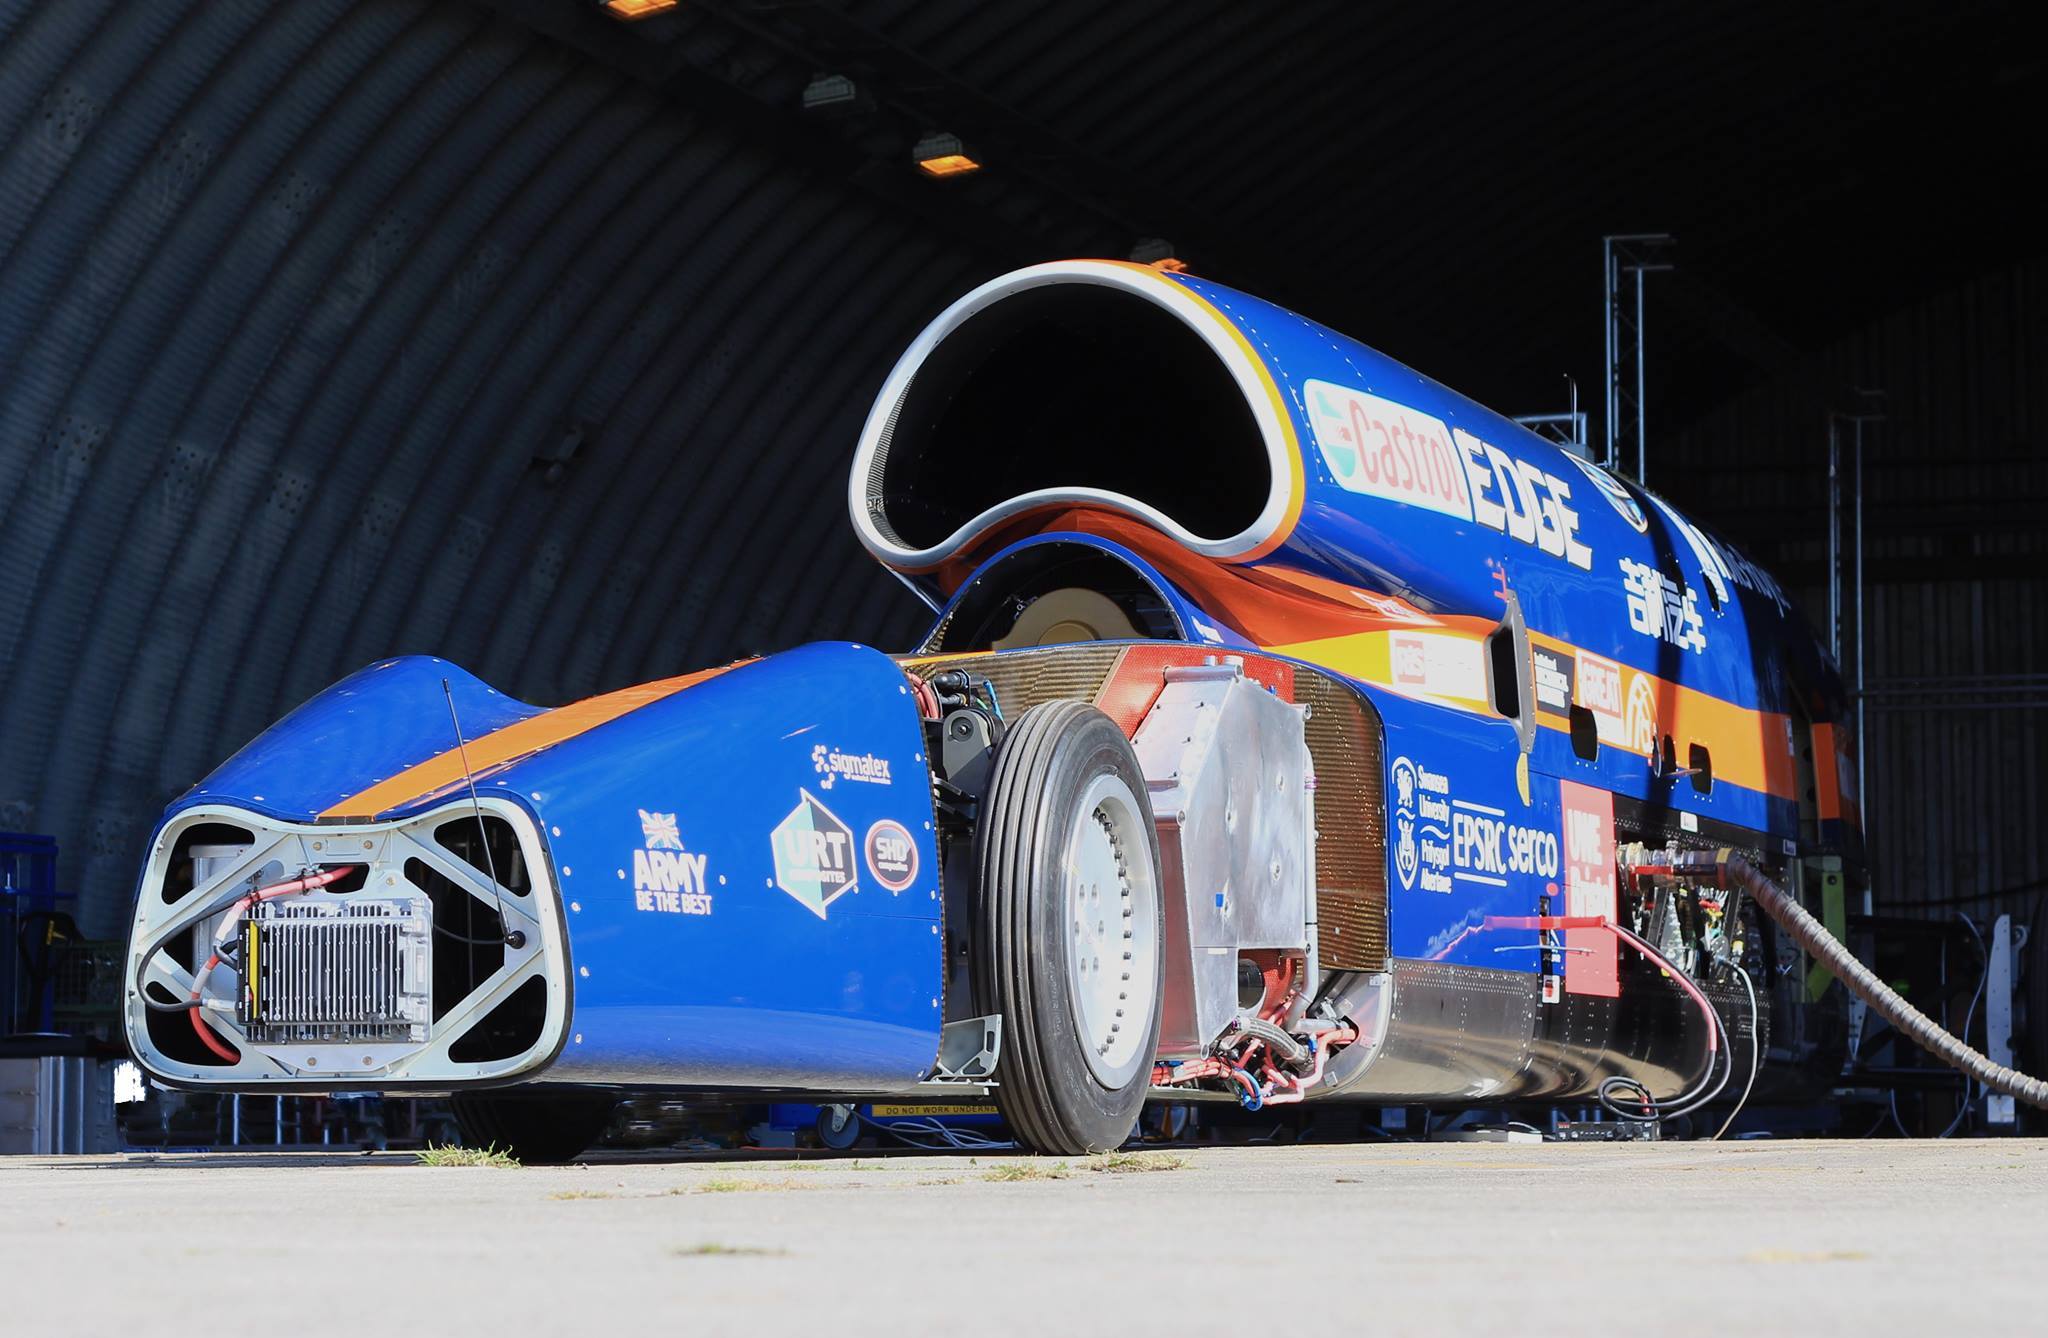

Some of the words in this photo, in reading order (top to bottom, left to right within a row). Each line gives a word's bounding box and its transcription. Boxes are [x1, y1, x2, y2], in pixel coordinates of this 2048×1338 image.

[1349, 399, 1465, 506] Castrol
[1452, 427, 1592, 571] EDGE
[828, 747, 891, 780] sigmatex
[783, 830, 846, 870] URT
[876, 837, 907, 862] SHD
[1453, 812, 1507, 875] EPSRC
[1508, 825, 1558, 878] serco
[634, 849, 707, 894] ARMY
[636, 890, 655, 911] BE
[654, 891, 681, 913] THE
[681, 893, 712, 915] BEST
[886, 1107, 899, 1115] DO
[923, 1106, 950, 1114] WORK
